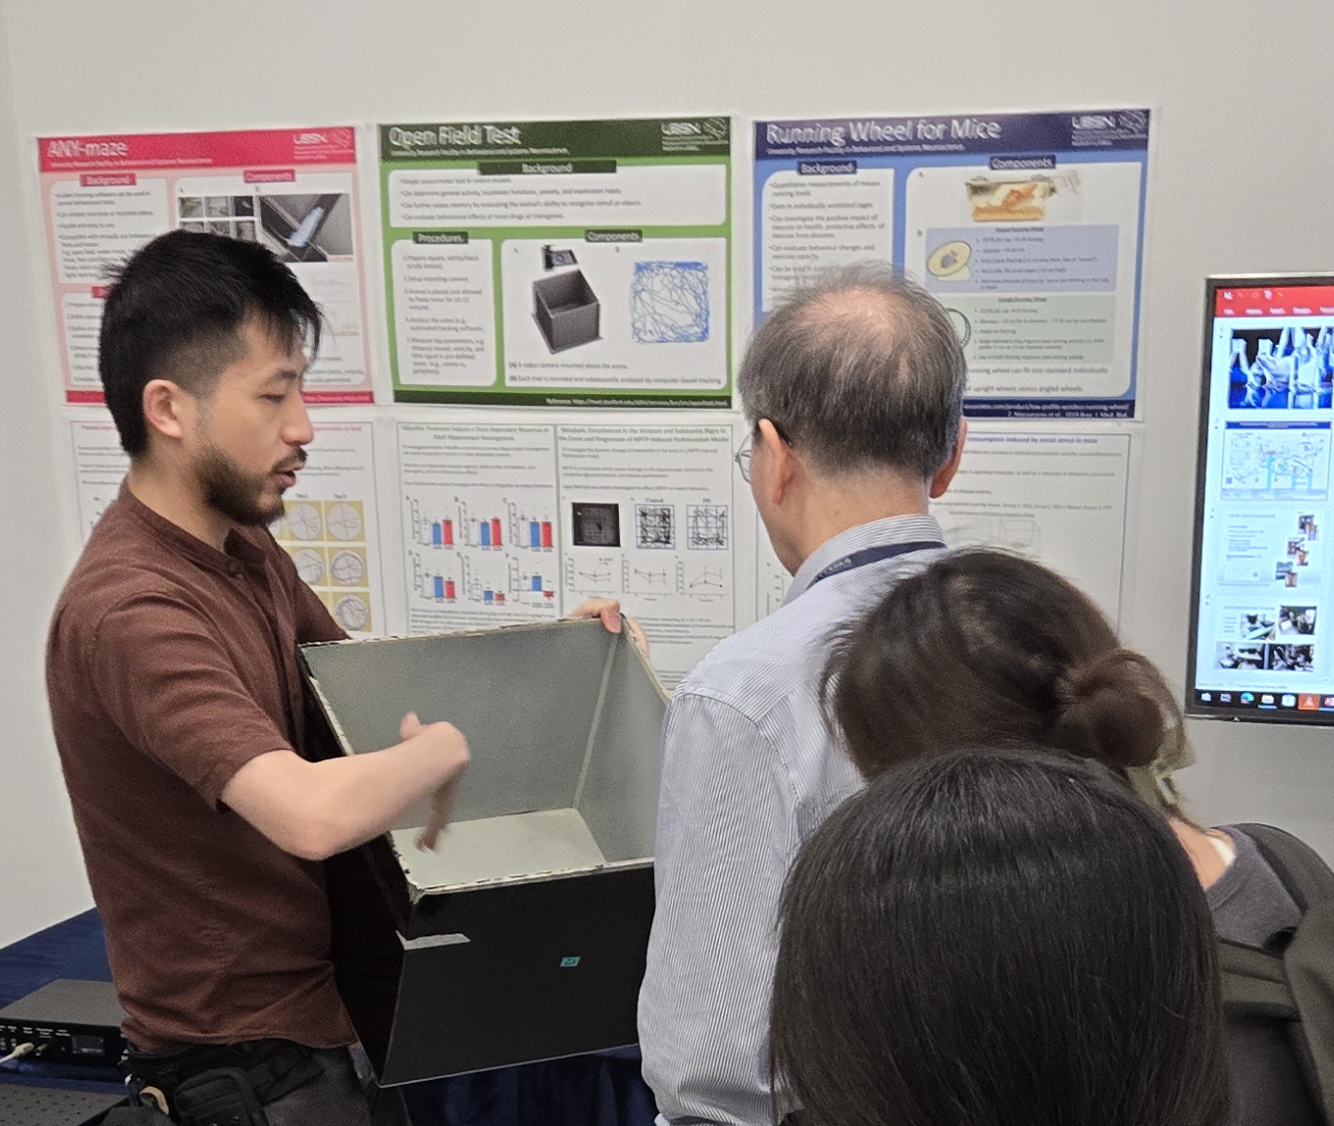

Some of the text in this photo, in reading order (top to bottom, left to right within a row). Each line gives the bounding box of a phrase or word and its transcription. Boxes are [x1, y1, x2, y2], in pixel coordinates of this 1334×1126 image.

[389, 124, 522, 150] Open Field Test
[766, 117, 1003, 147] Running Wheel for Mice
[800, 163, 855, 174] Background
[992, 157, 1054, 169] Components
